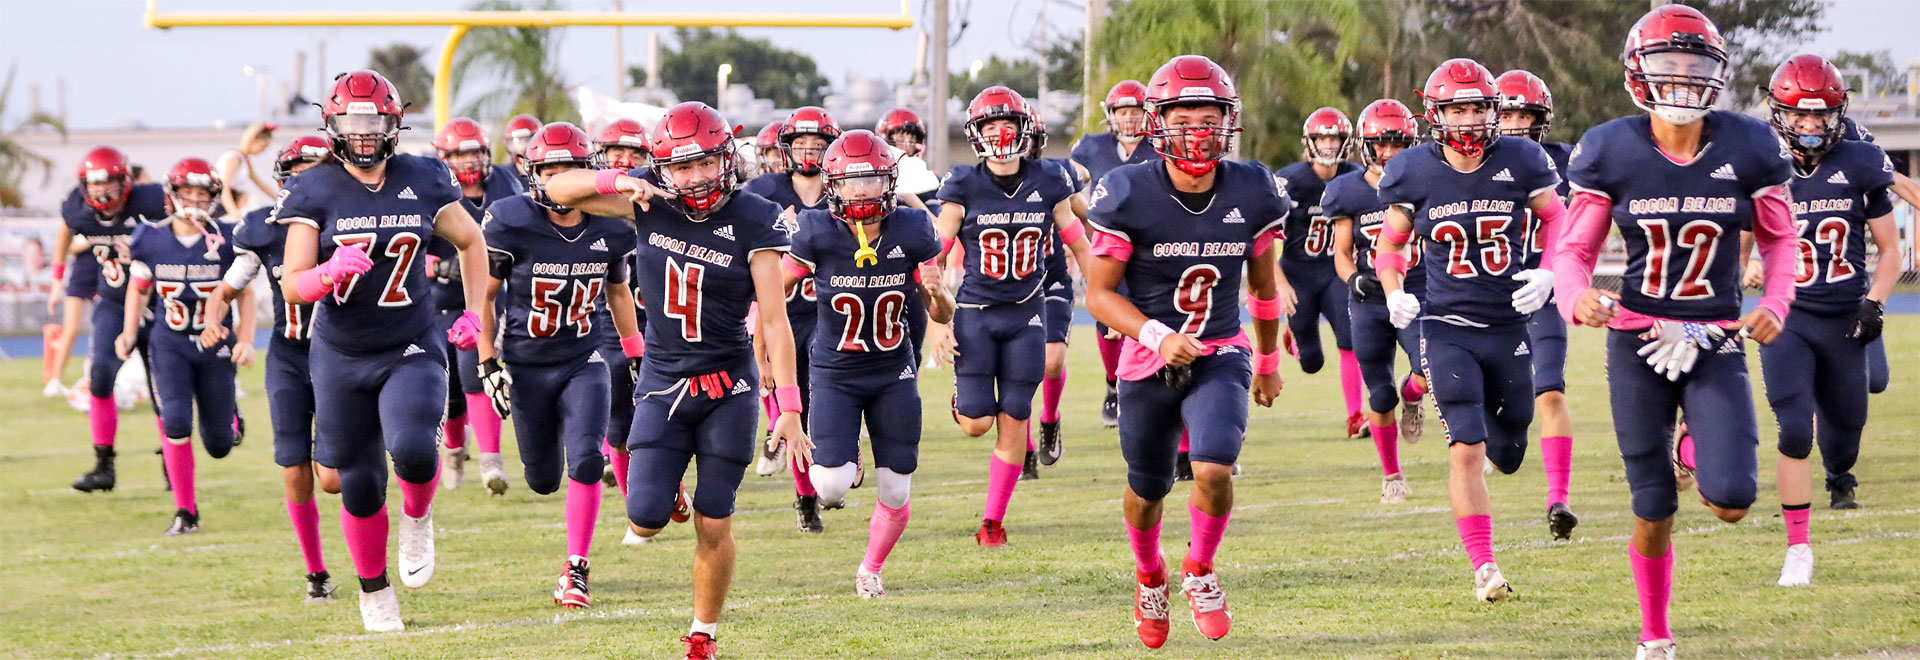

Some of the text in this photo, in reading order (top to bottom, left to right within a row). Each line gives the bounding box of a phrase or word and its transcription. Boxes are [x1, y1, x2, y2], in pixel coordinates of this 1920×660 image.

[1429, 200, 1515, 220] COCOA BEACH
[1629, 196, 1737, 215] COCOA BEACH
[1808, 198, 1853, 213] BEACH
[336, 214, 421, 231] COCOA BEACH
[977, 212, 1046, 225] COCOA BEACH
[1360, 210, 1388, 225] COCO
[713, 228, 736, 241] adidas
[648, 232, 733, 268] COCOA BEACH
[978, 226, 1043, 280] 80
[1153, 242, 1247, 257] COCOA BEACH
[1431, 215, 1513, 279] 25
[332, 231, 421, 307] 72
[532, 262, 608, 276] COCOA BEACH
[1636, 218, 1724, 300] 12
[830, 273, 906, 288] COCOA BEACH
[527, 276, 604, 338] 54
[663, 255, 705, 343] 4
[1173, 263, 1222, 338] 9
[830, 290, 906, 352] 20
